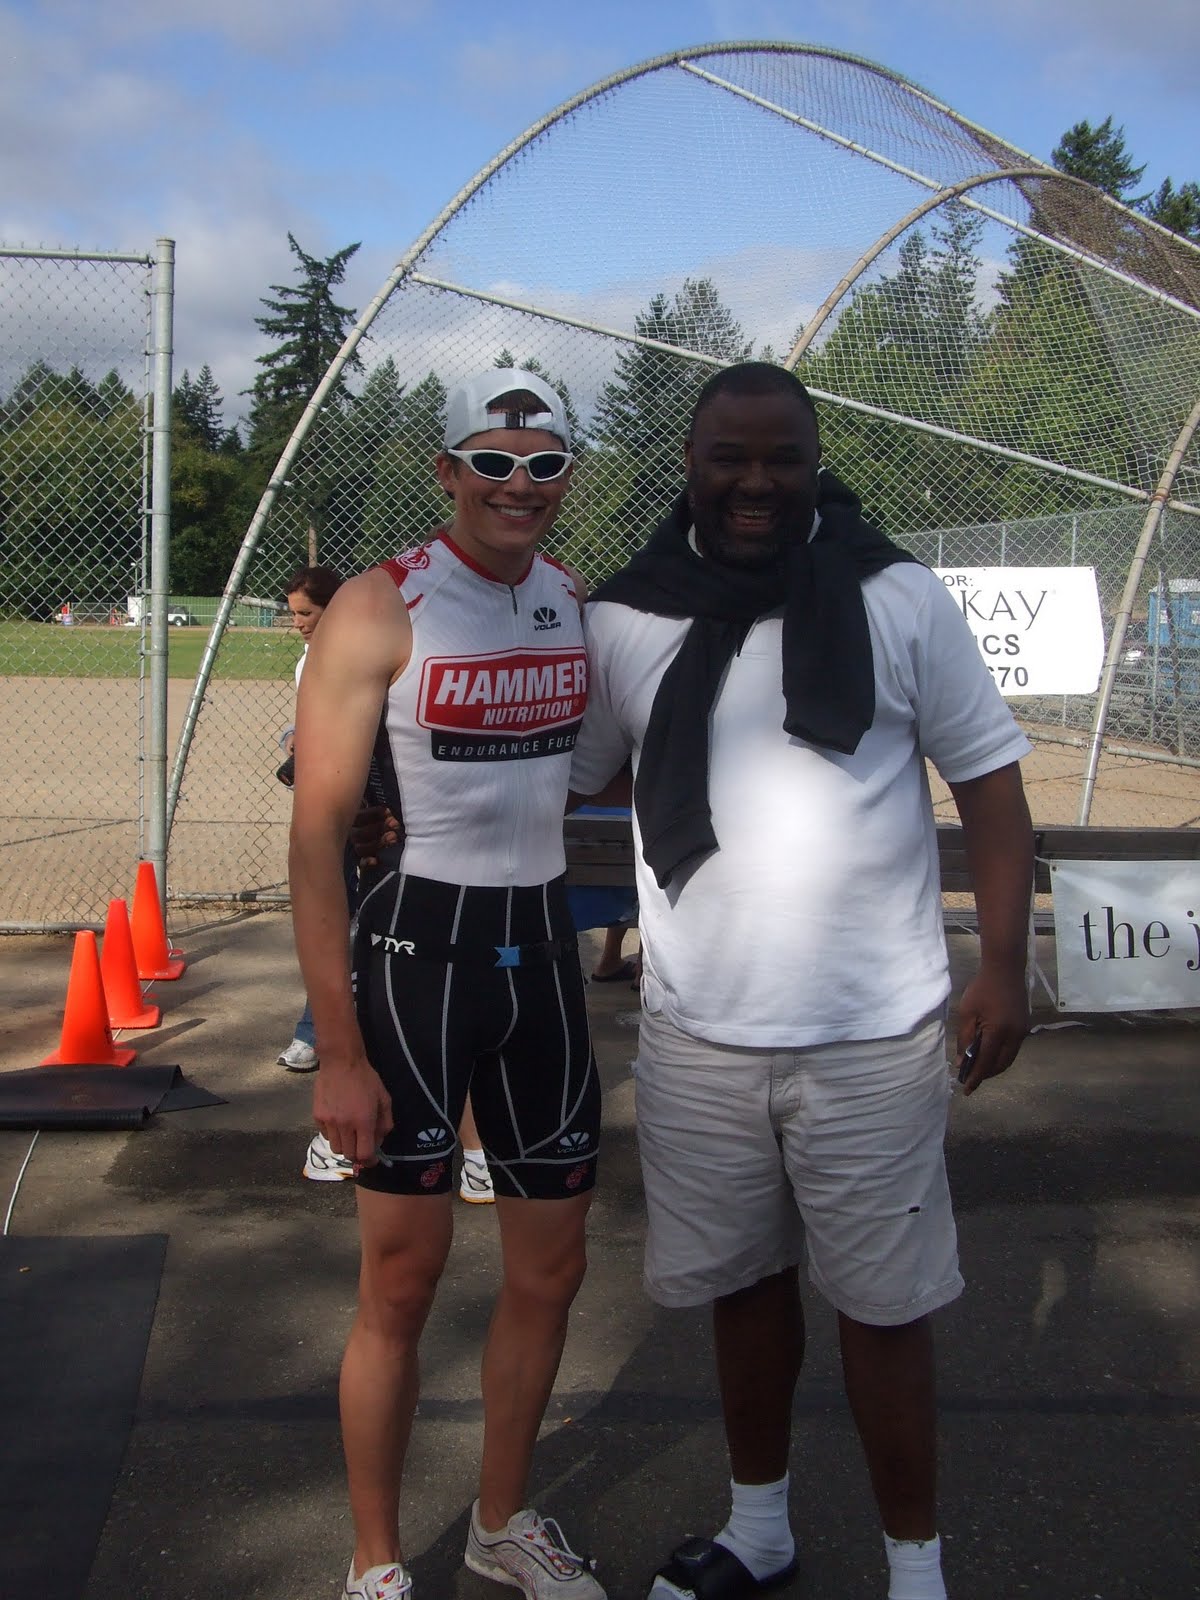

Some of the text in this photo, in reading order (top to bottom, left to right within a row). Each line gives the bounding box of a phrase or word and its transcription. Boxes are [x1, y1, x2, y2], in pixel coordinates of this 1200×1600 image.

[975, 634, 1020, 655] CS
[434, 659, 587, 705] HAMMER
[988, 666, 1028, 687] 70
[482, 700, 573, 725] NUTRITION
[438, 739, 540, 755] ENDURANCE
[1078, 906, 1171, 961] the
[384, 937, 416, 955] TYR
